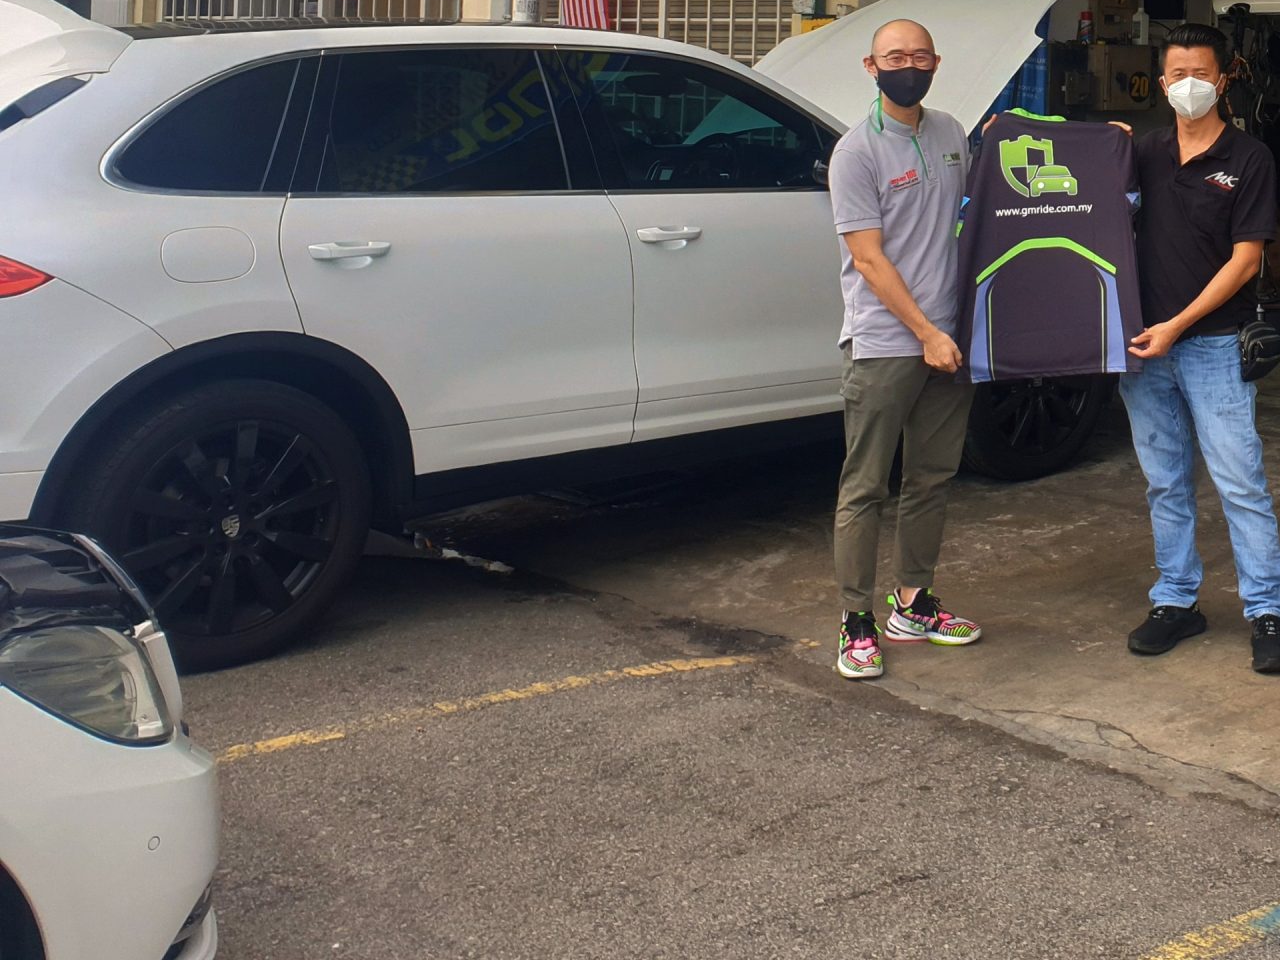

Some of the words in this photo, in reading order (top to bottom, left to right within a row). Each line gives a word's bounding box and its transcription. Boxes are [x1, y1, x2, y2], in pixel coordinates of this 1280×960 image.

[1131, 75, 1149, 97] 20
[1204, 171, 1239, 188] MK
[995, 203, 1094, 218] www.gmride.com.my
